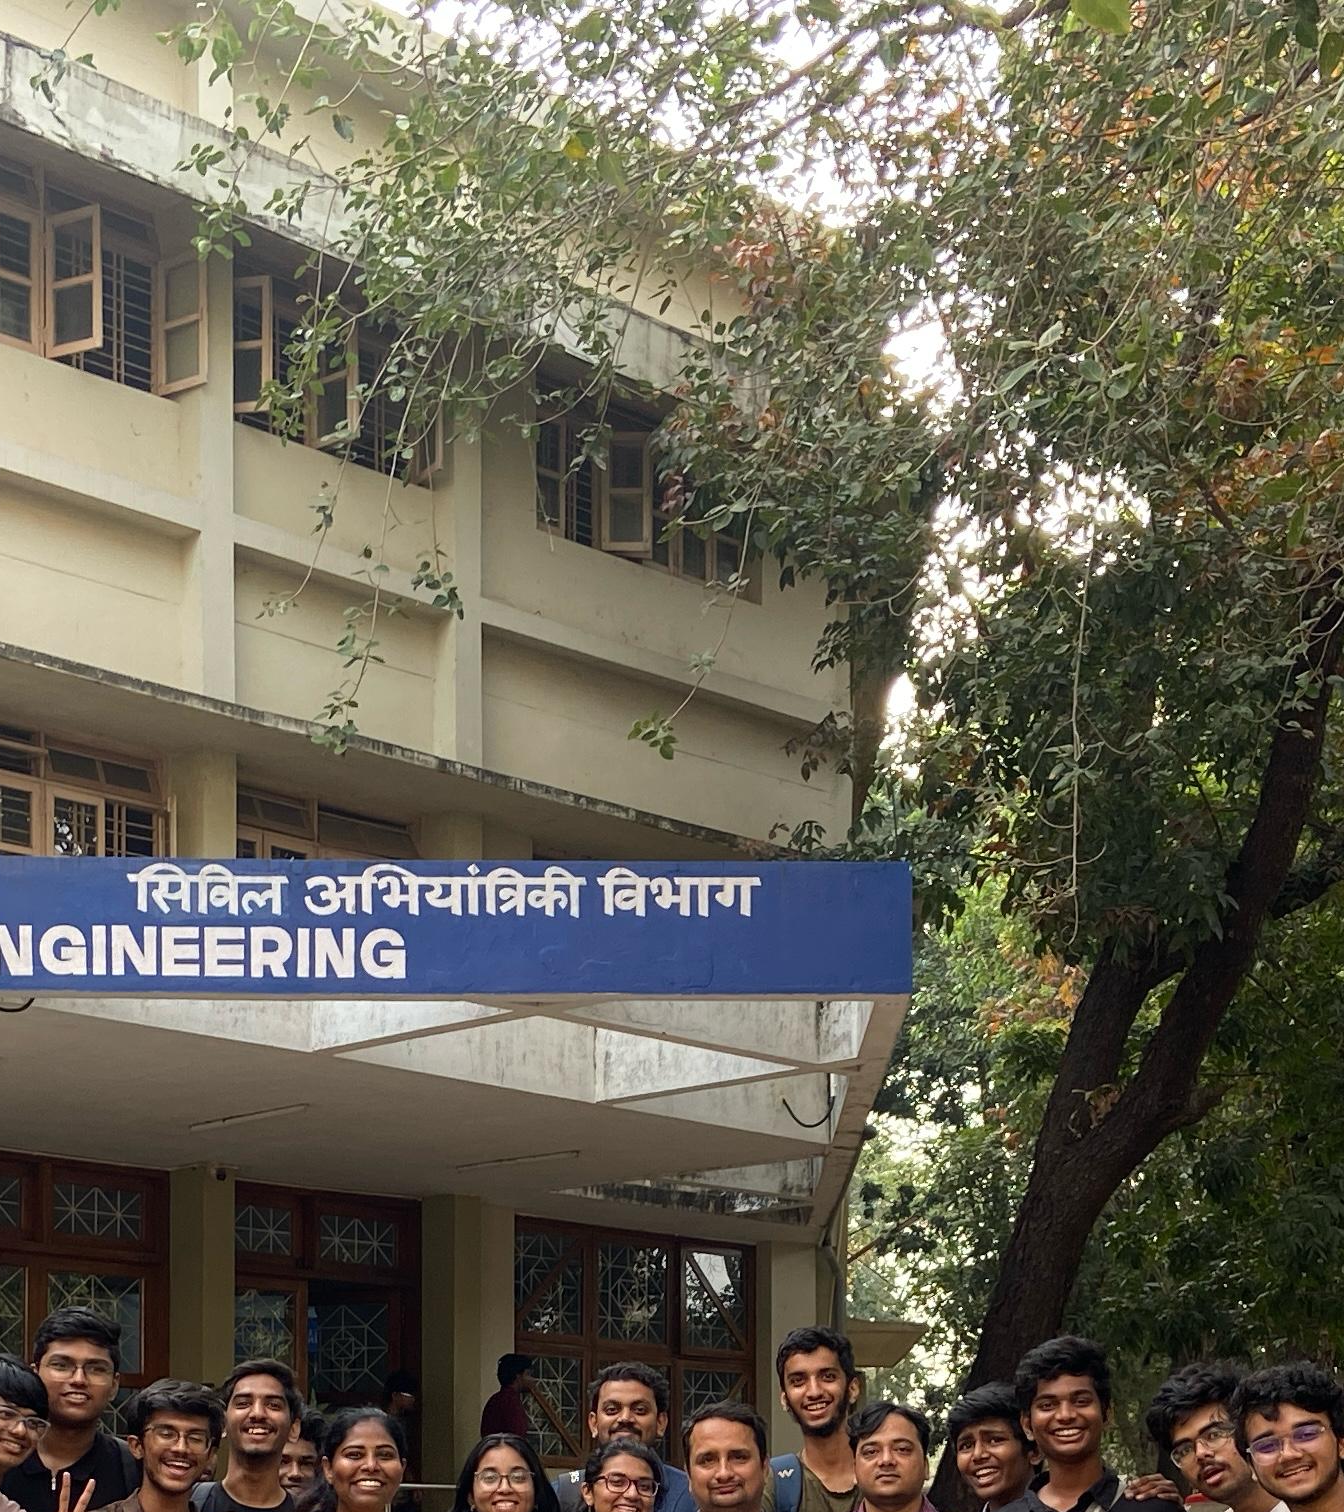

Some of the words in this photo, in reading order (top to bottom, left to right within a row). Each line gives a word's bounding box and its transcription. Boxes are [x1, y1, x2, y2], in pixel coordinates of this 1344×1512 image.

[126, 863, 289, 916] सिविल
[304, 863, 587, 918] अभियांत्रिकी
[597, 867, 762, 918] विभाग
